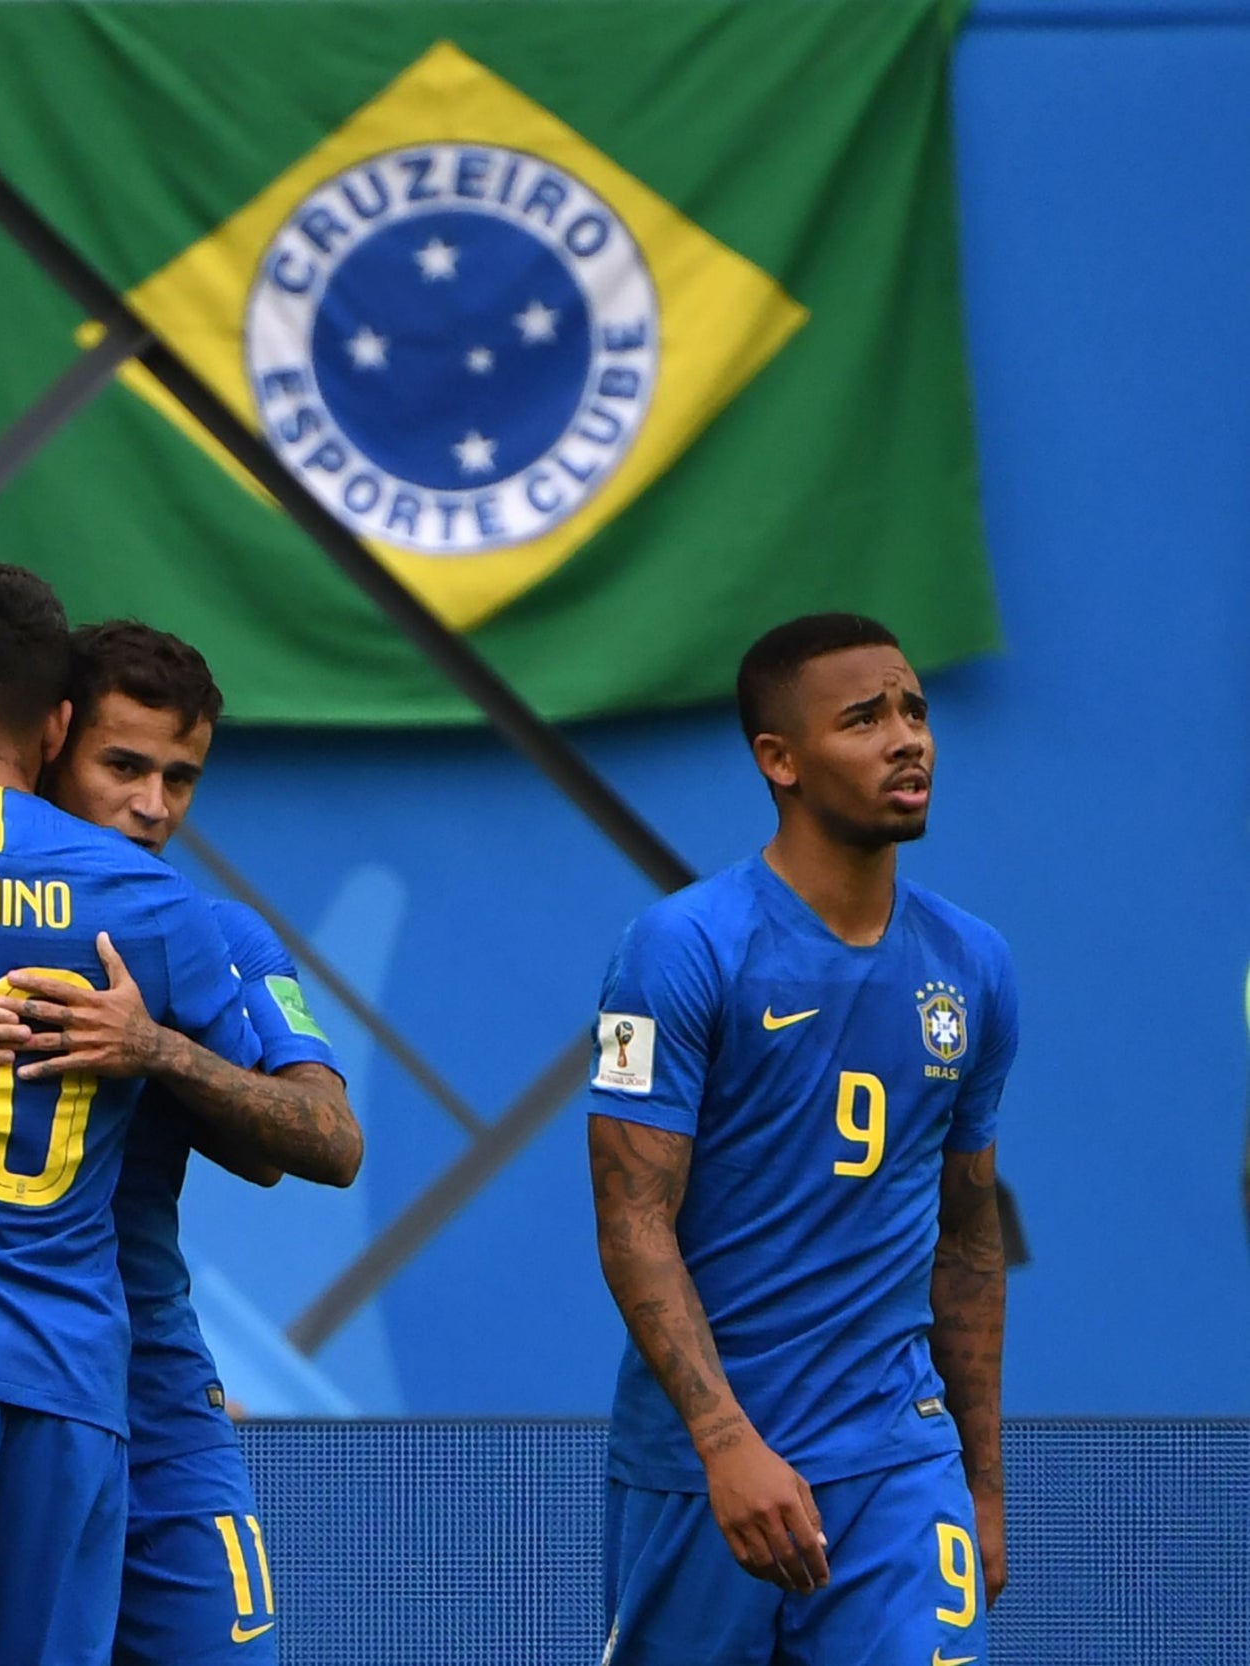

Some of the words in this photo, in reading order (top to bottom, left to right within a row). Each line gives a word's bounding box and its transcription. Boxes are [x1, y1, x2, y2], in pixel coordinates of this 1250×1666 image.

[272, 155, 609, 294] CRUZEIRO
[263, 369, 504, 540] ESPORTE
[526, 322, 646, 512] CLUBE
[834, 1071, 886, 1177] 9
[924, 1064, 960, 1081] BRASI
[214, 1515, 274, 1614] 11
[936, 1523, 975, 1628] 9
